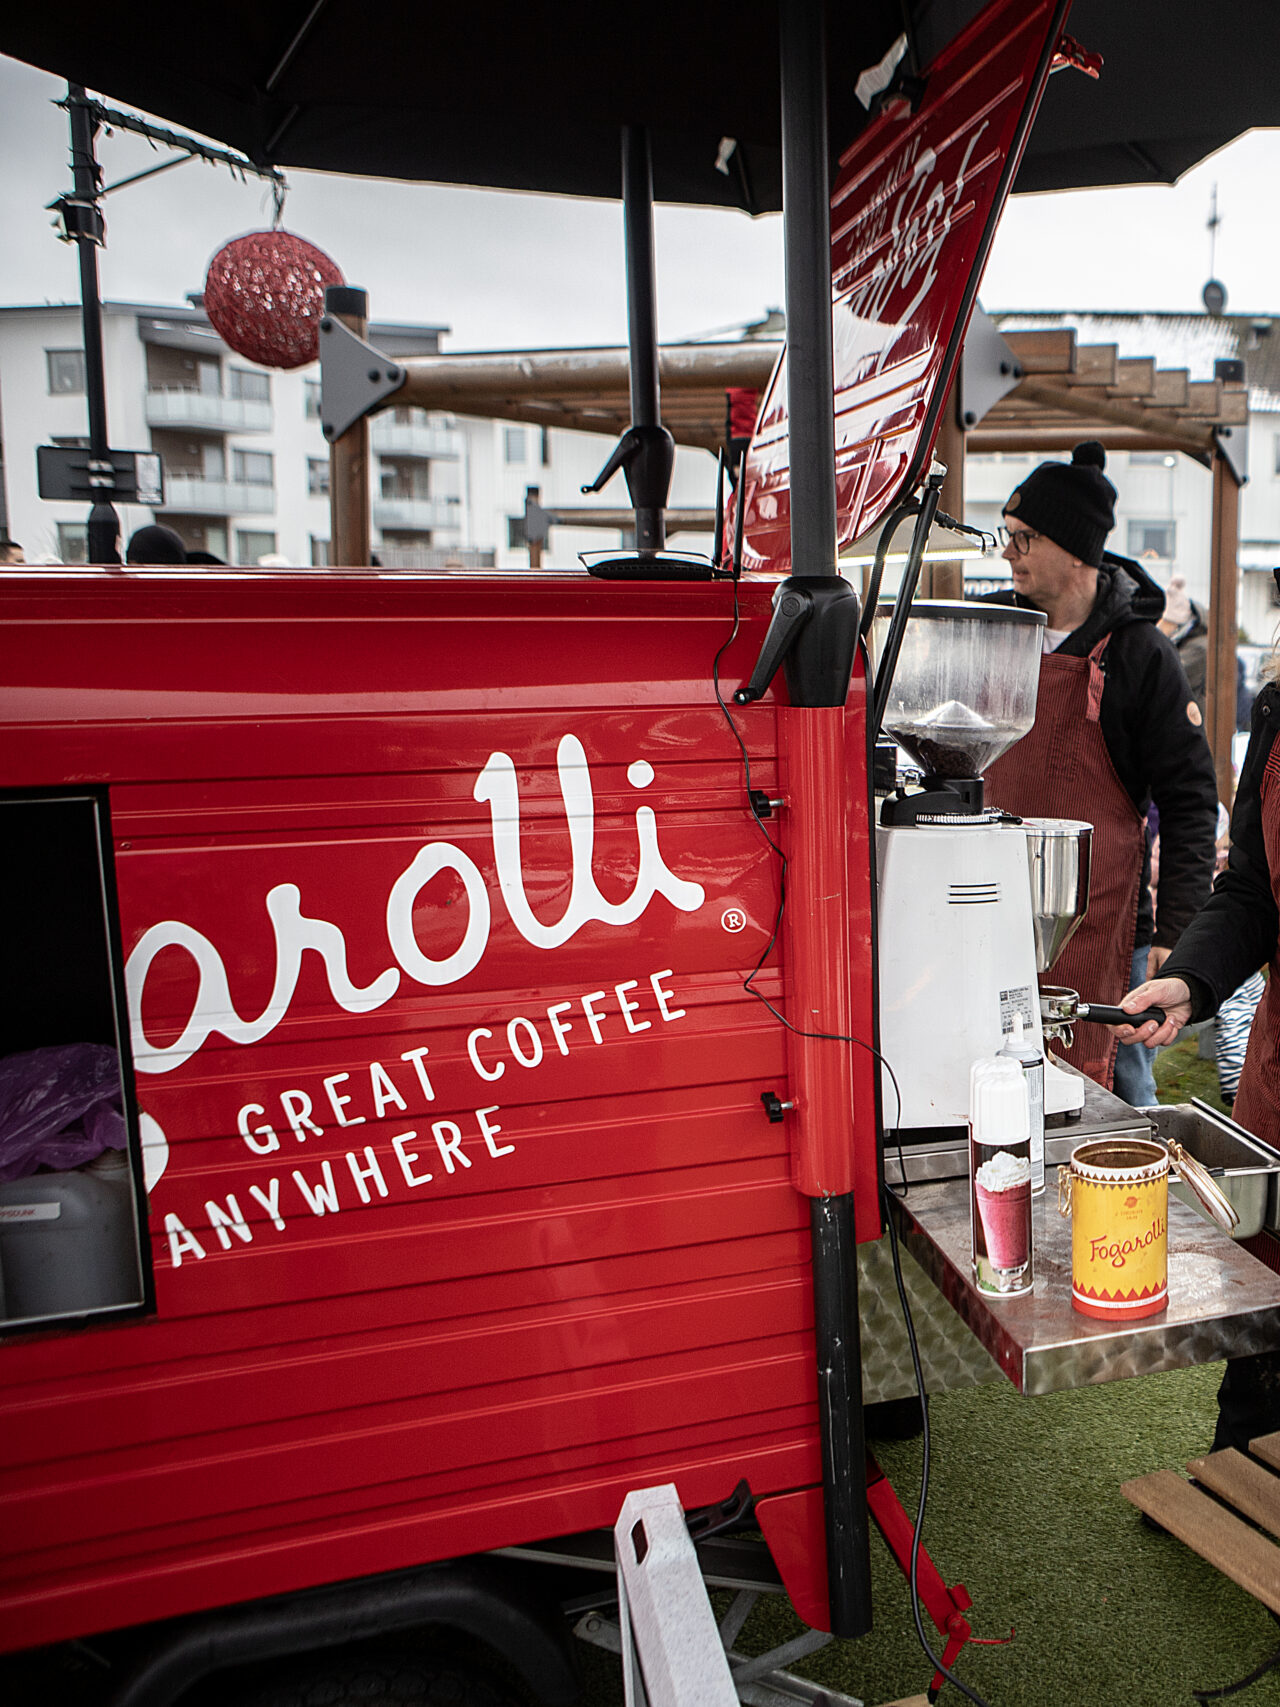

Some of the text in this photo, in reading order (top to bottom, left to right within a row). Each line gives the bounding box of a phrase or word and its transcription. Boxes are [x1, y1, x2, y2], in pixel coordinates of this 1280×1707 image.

[124, 732, 705, 1193] arolli
[237, 968, 686, 1155] GREAT COFFEE
[163, 1104, 516, 1267] ANYWHERE
[1089, 1217, 1165, 1268] Fogarolli
